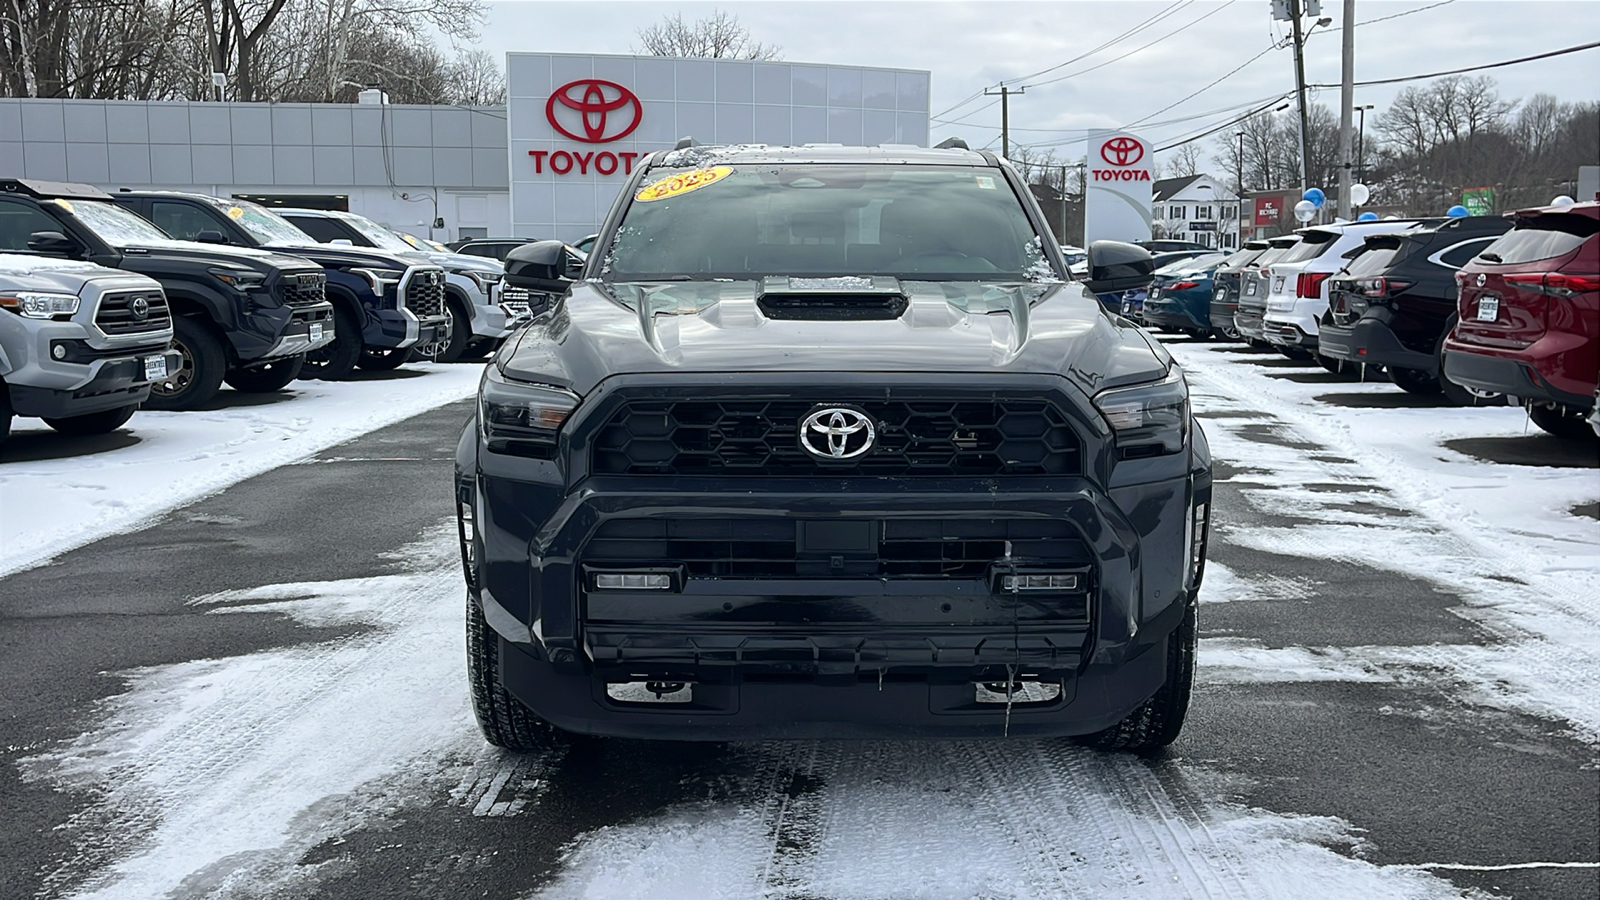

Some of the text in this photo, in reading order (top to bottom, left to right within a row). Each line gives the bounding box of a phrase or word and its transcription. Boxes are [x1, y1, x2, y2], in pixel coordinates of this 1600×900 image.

[528, 150, 650, 175] TOYOT
[1092, 169, 1151, 181] TOYOTA
[654, 169, 717, 198] 2025
